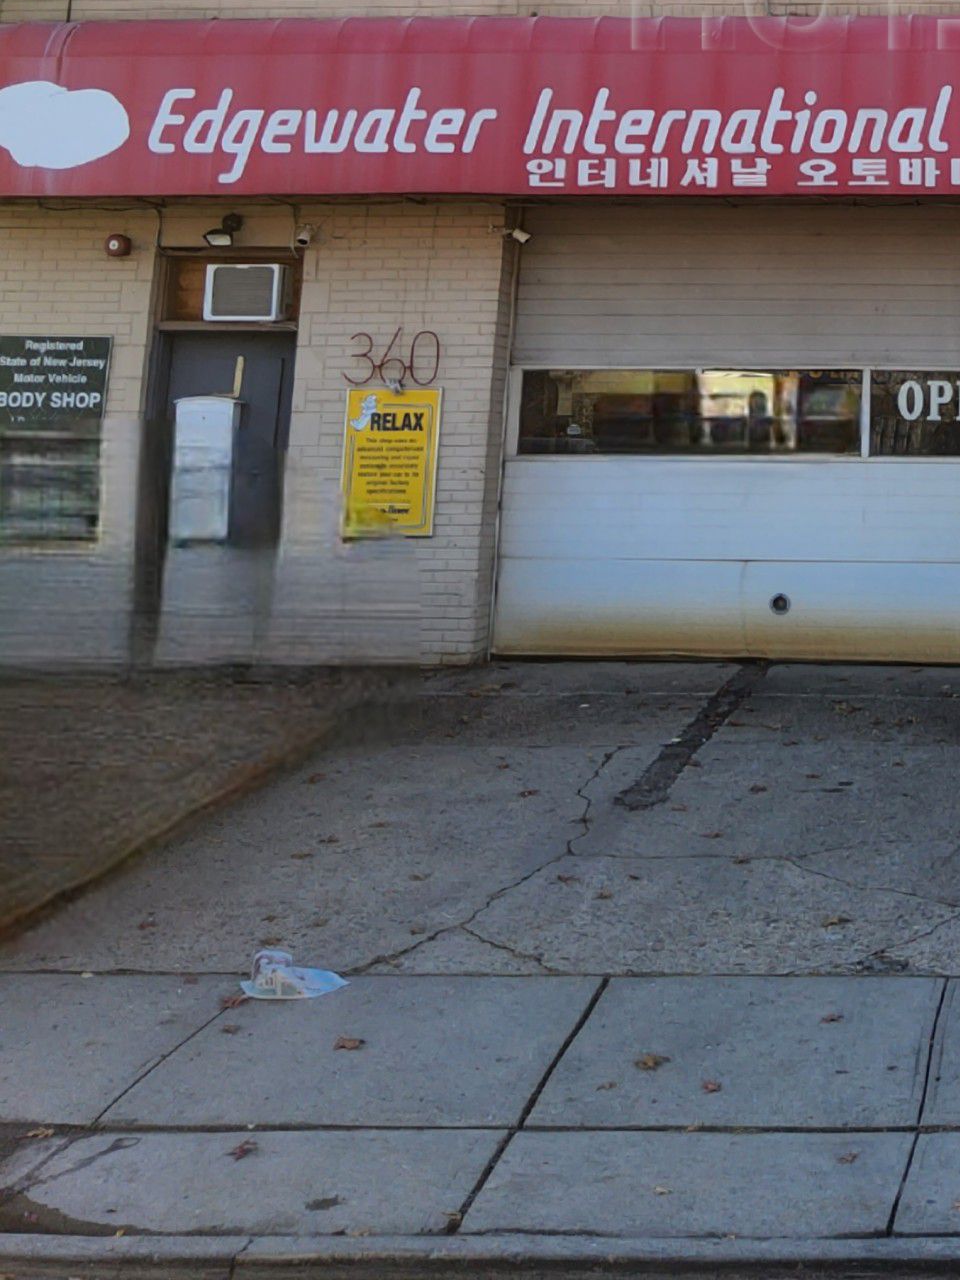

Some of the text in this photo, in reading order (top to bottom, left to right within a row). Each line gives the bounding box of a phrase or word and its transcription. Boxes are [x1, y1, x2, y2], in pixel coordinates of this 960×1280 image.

[148, 86, 498, 184] Edgewater
[523, 85, 953, 155] International
[526, 157, 772, 188] 인터네셔날
[25, 340, 84, 353] Registered
[0, 356, 106, 370] State of New Jersey
[342, 326, 440, 386] 360
[14, 373, 88, 383] Motor Vehicle
[0, 392, 101, 408] BODY SHOP
[370, 412, 425, 432] RELAX
